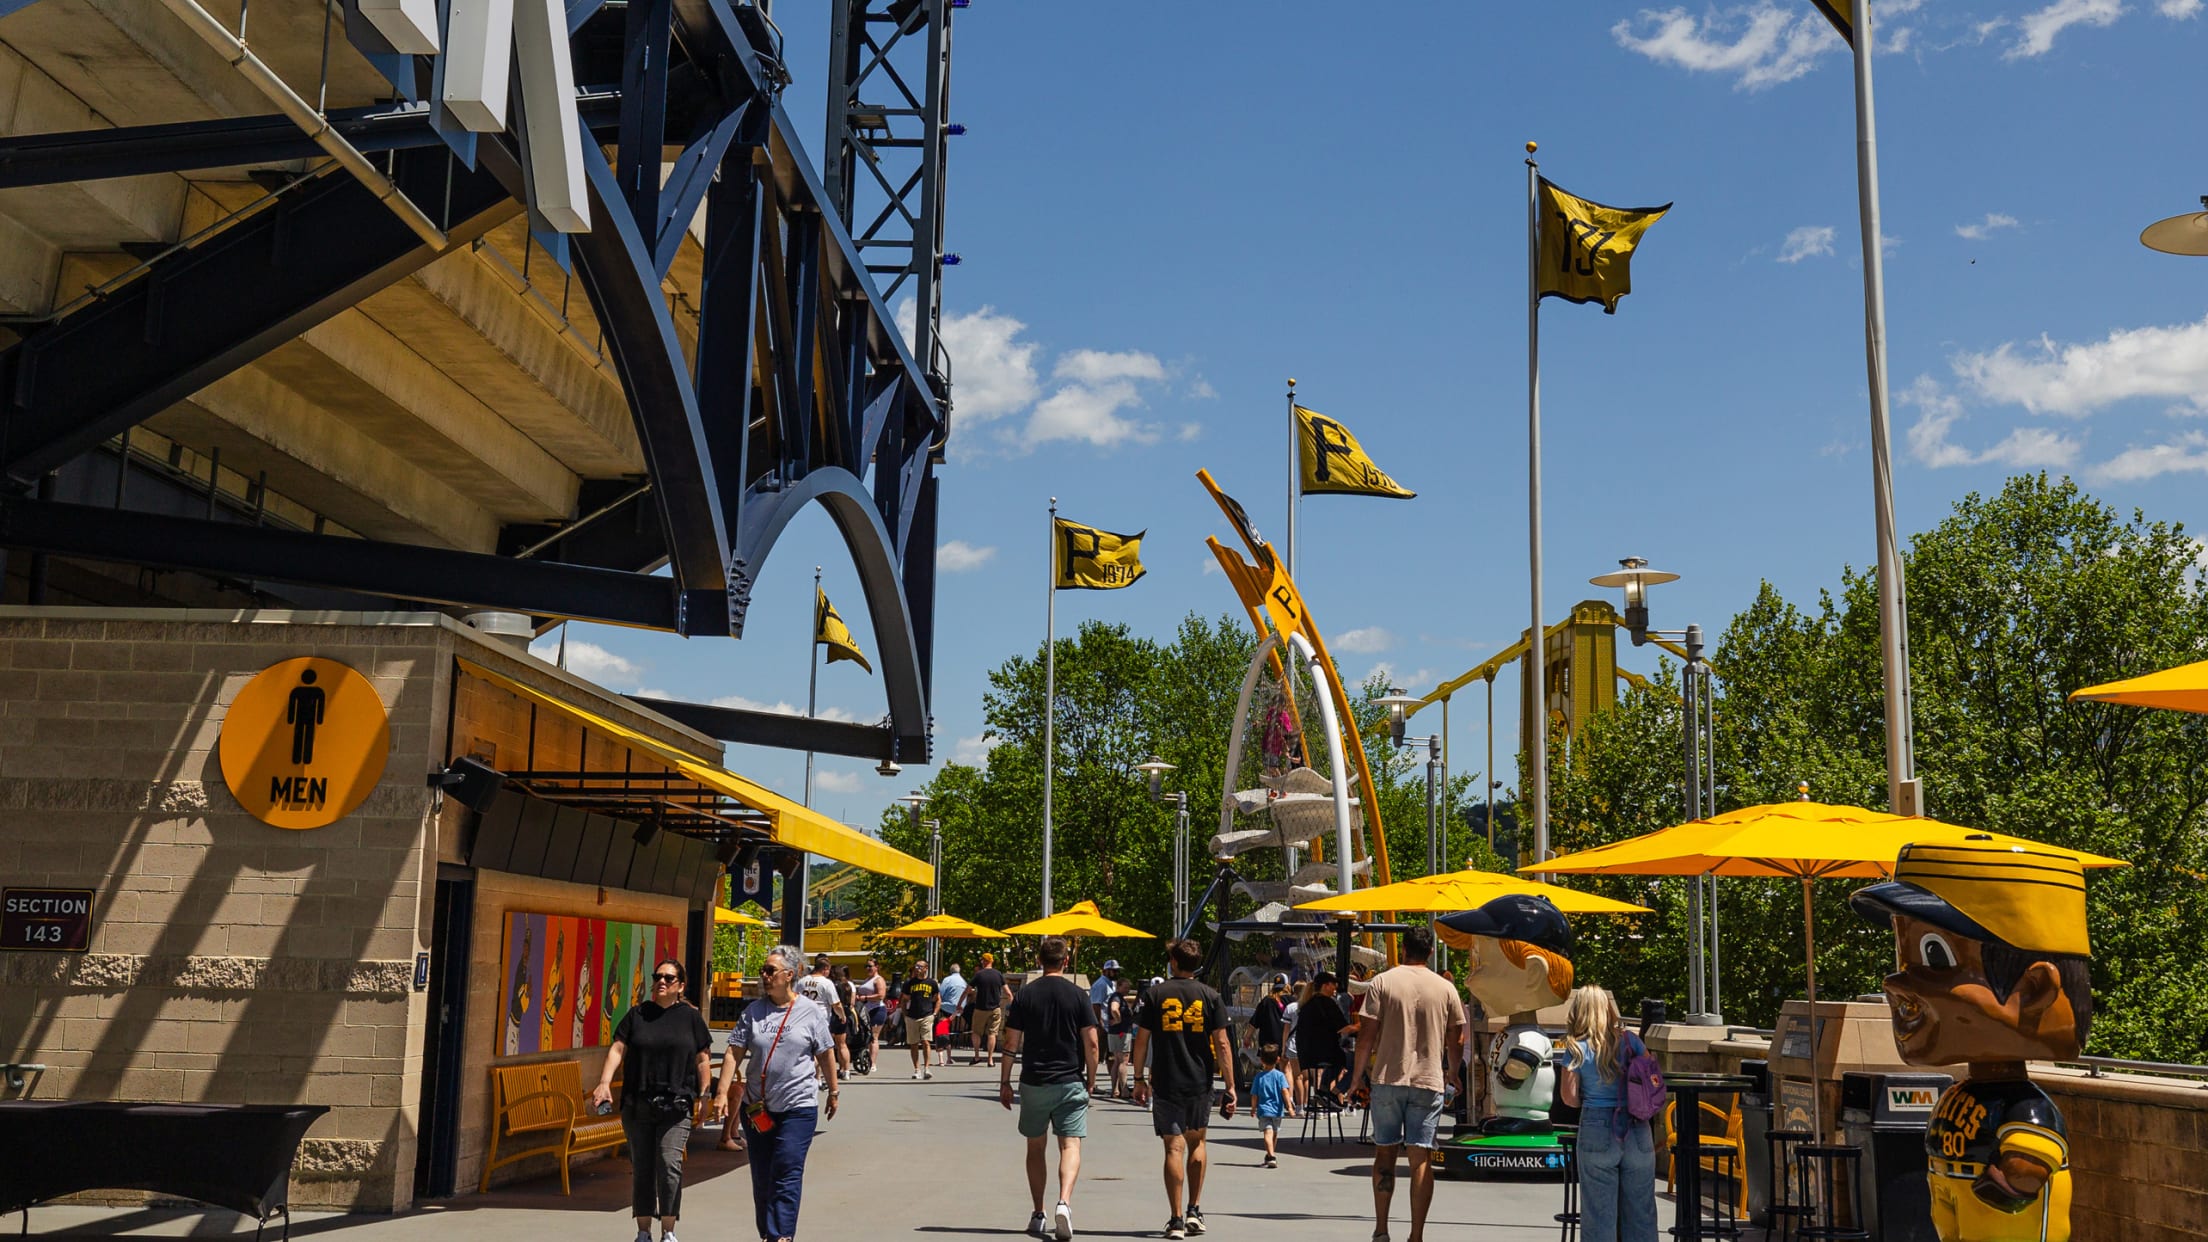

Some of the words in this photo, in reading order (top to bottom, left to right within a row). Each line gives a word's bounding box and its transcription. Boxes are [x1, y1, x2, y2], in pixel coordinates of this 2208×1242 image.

[1065, 527, 1100, 580] P
[1103, 564, 1135, 584] 1974
[269, 775, 328, 803] MEN
[6, 898, 87, 914] SECTION
[25, 925, 62, 942] 143
[1161, 997, 1204, 1033] 24
[1892, 1091, 1933, 1105] WM
[1943, 1131, 1965, 1157] 80
